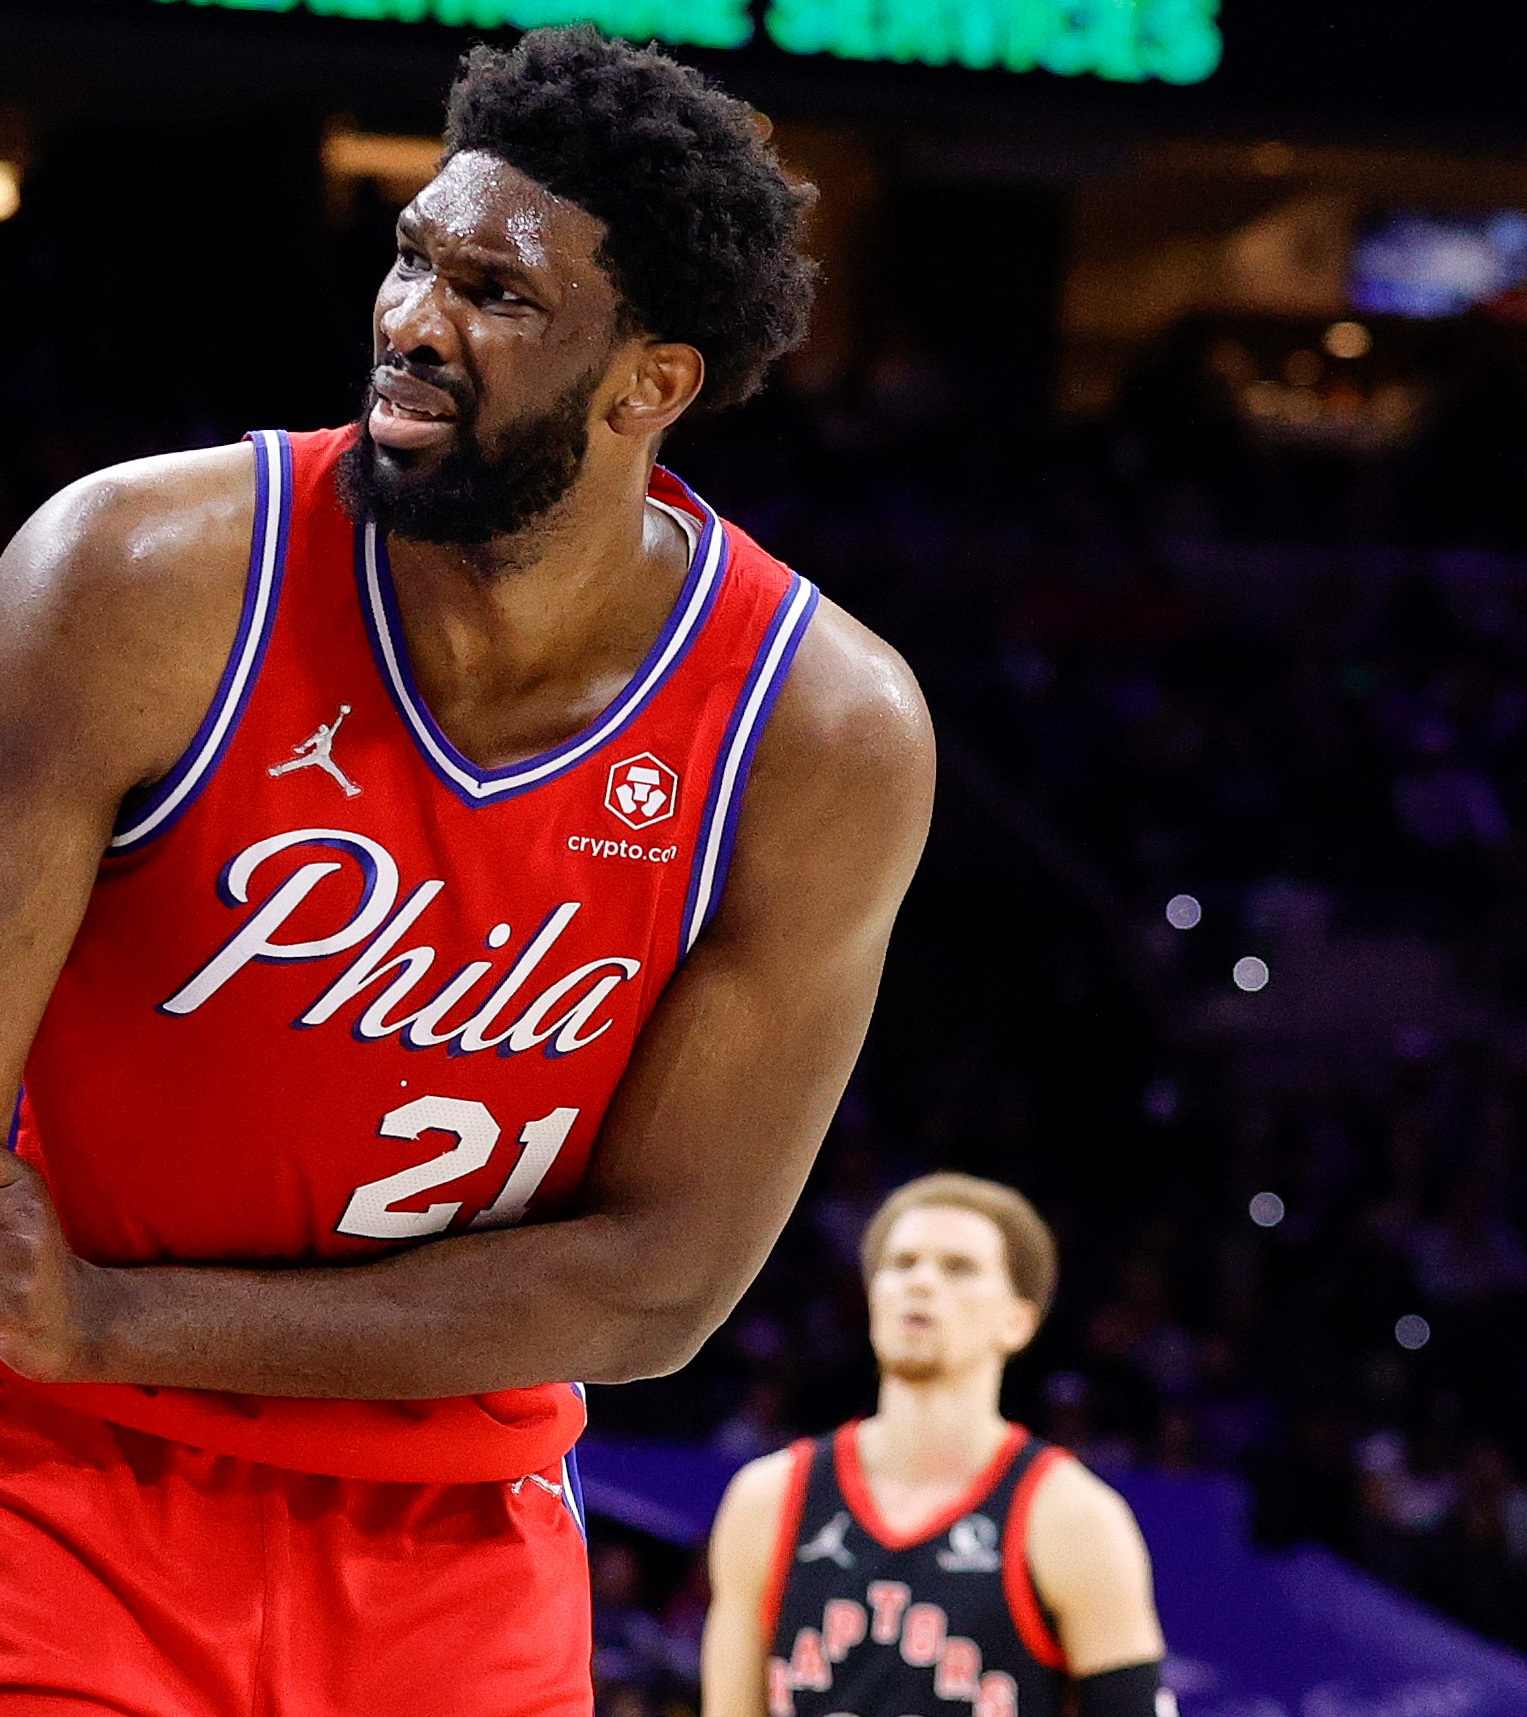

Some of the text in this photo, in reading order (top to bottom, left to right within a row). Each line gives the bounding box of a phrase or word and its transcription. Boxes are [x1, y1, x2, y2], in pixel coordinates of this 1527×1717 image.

[568, 835, 677, 863] crypto.co
[155, 828, 641, 1058] Phila
[336, 1095, 580, 1238] 21
